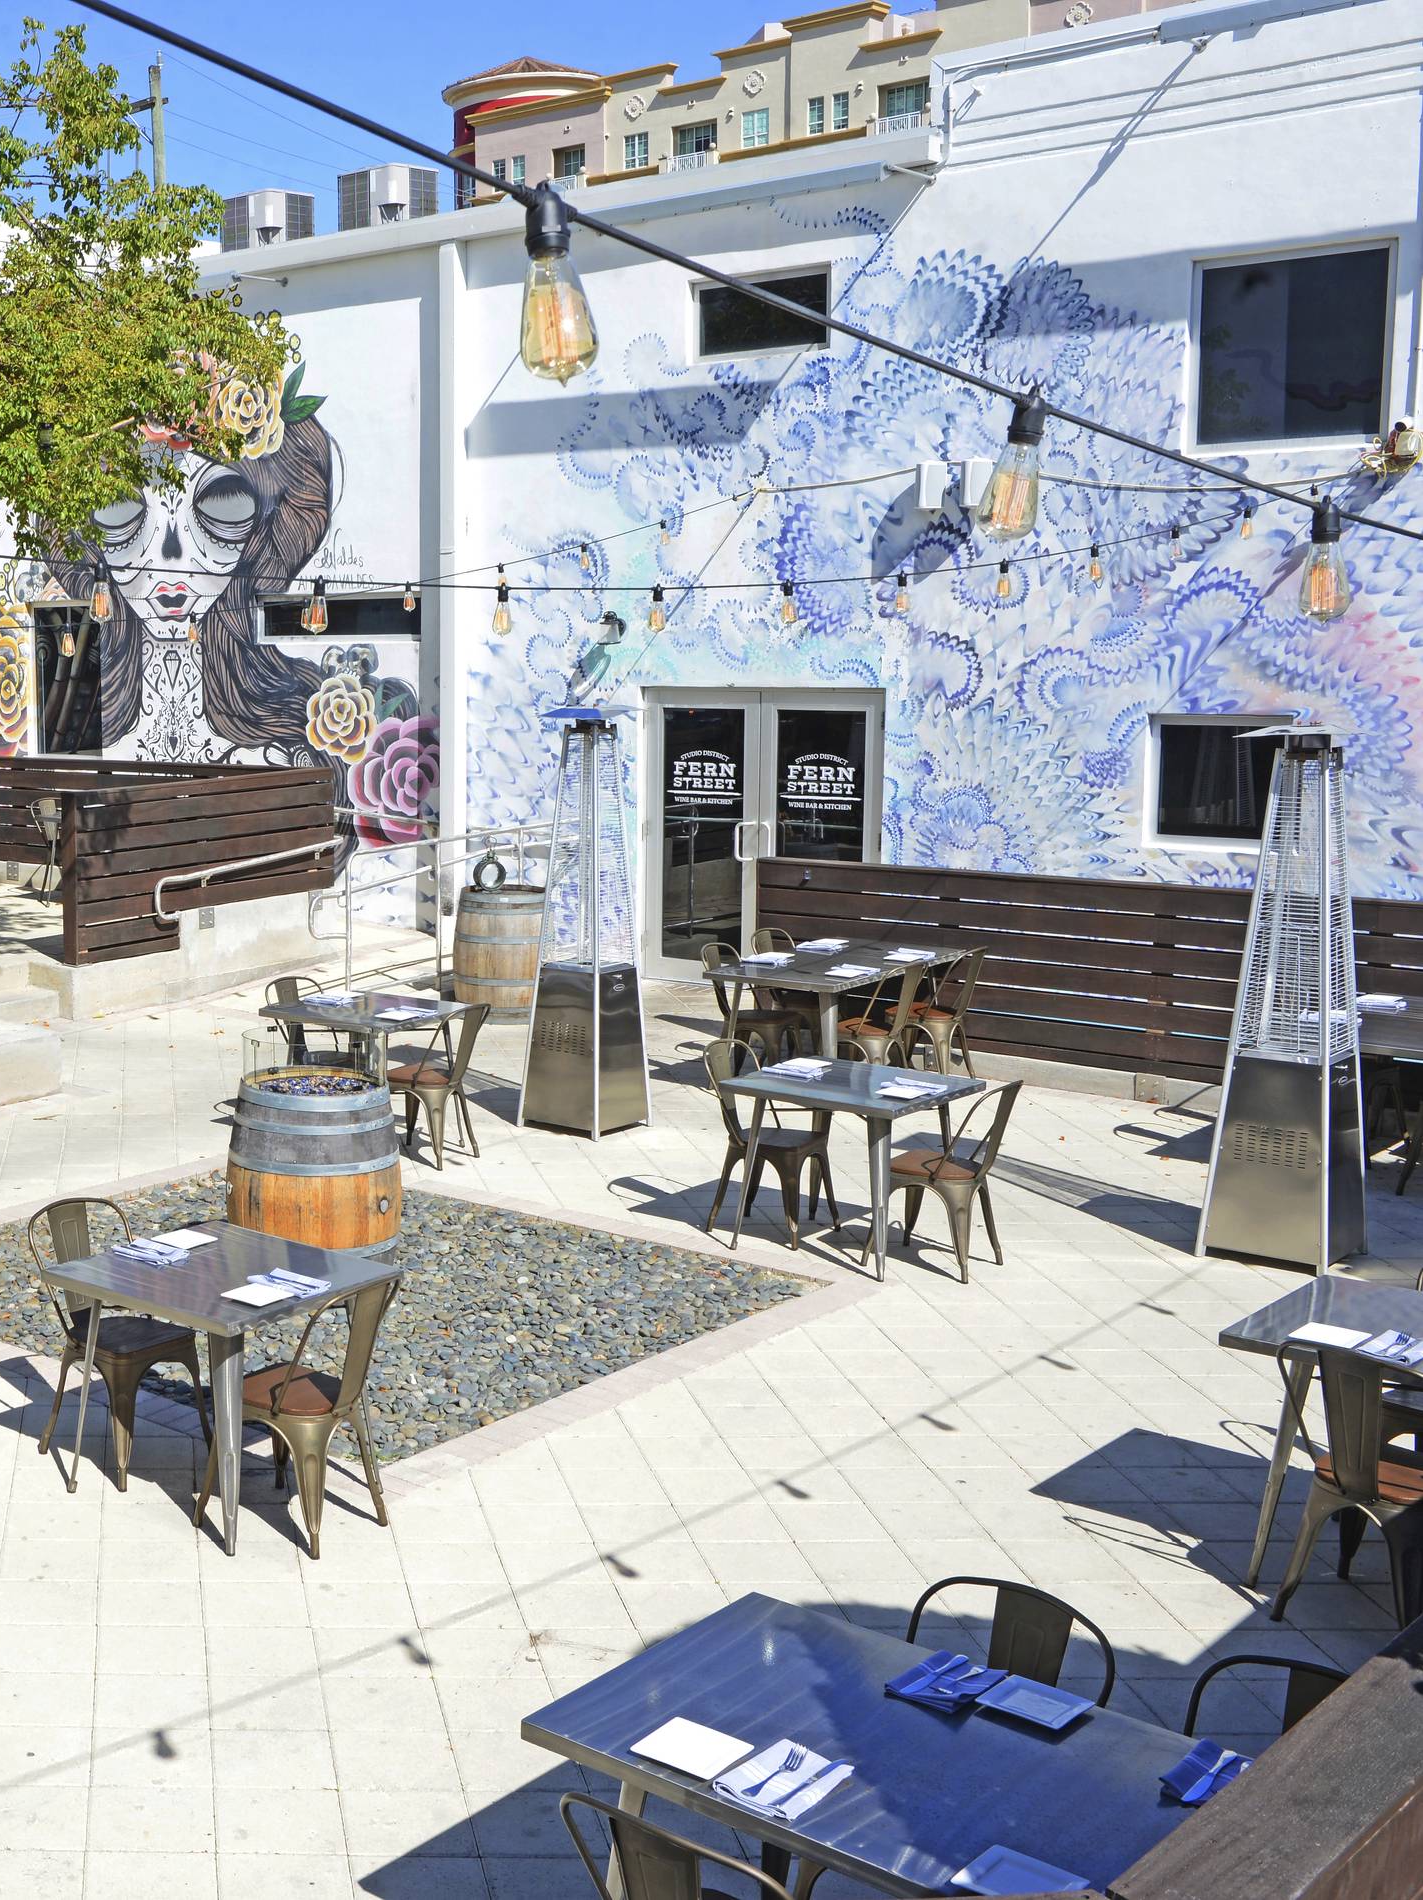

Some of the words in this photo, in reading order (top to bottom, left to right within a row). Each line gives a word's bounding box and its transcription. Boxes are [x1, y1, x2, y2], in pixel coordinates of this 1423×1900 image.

[680, 750, 703, 761] STUDIO
[702, 750, 730, 762] DISTRICT
[794, 753, 819, 765] STUDIO
[819, 753, 849, 766] DISTRICT
[673, 761, 737, 778] FERN
[787, 765, 856, 782] FERN
[673, 776, 736, 790] STREET
[787, 781, 856, 795] STREET
[824, 803, 852, 811] KITCHEN
